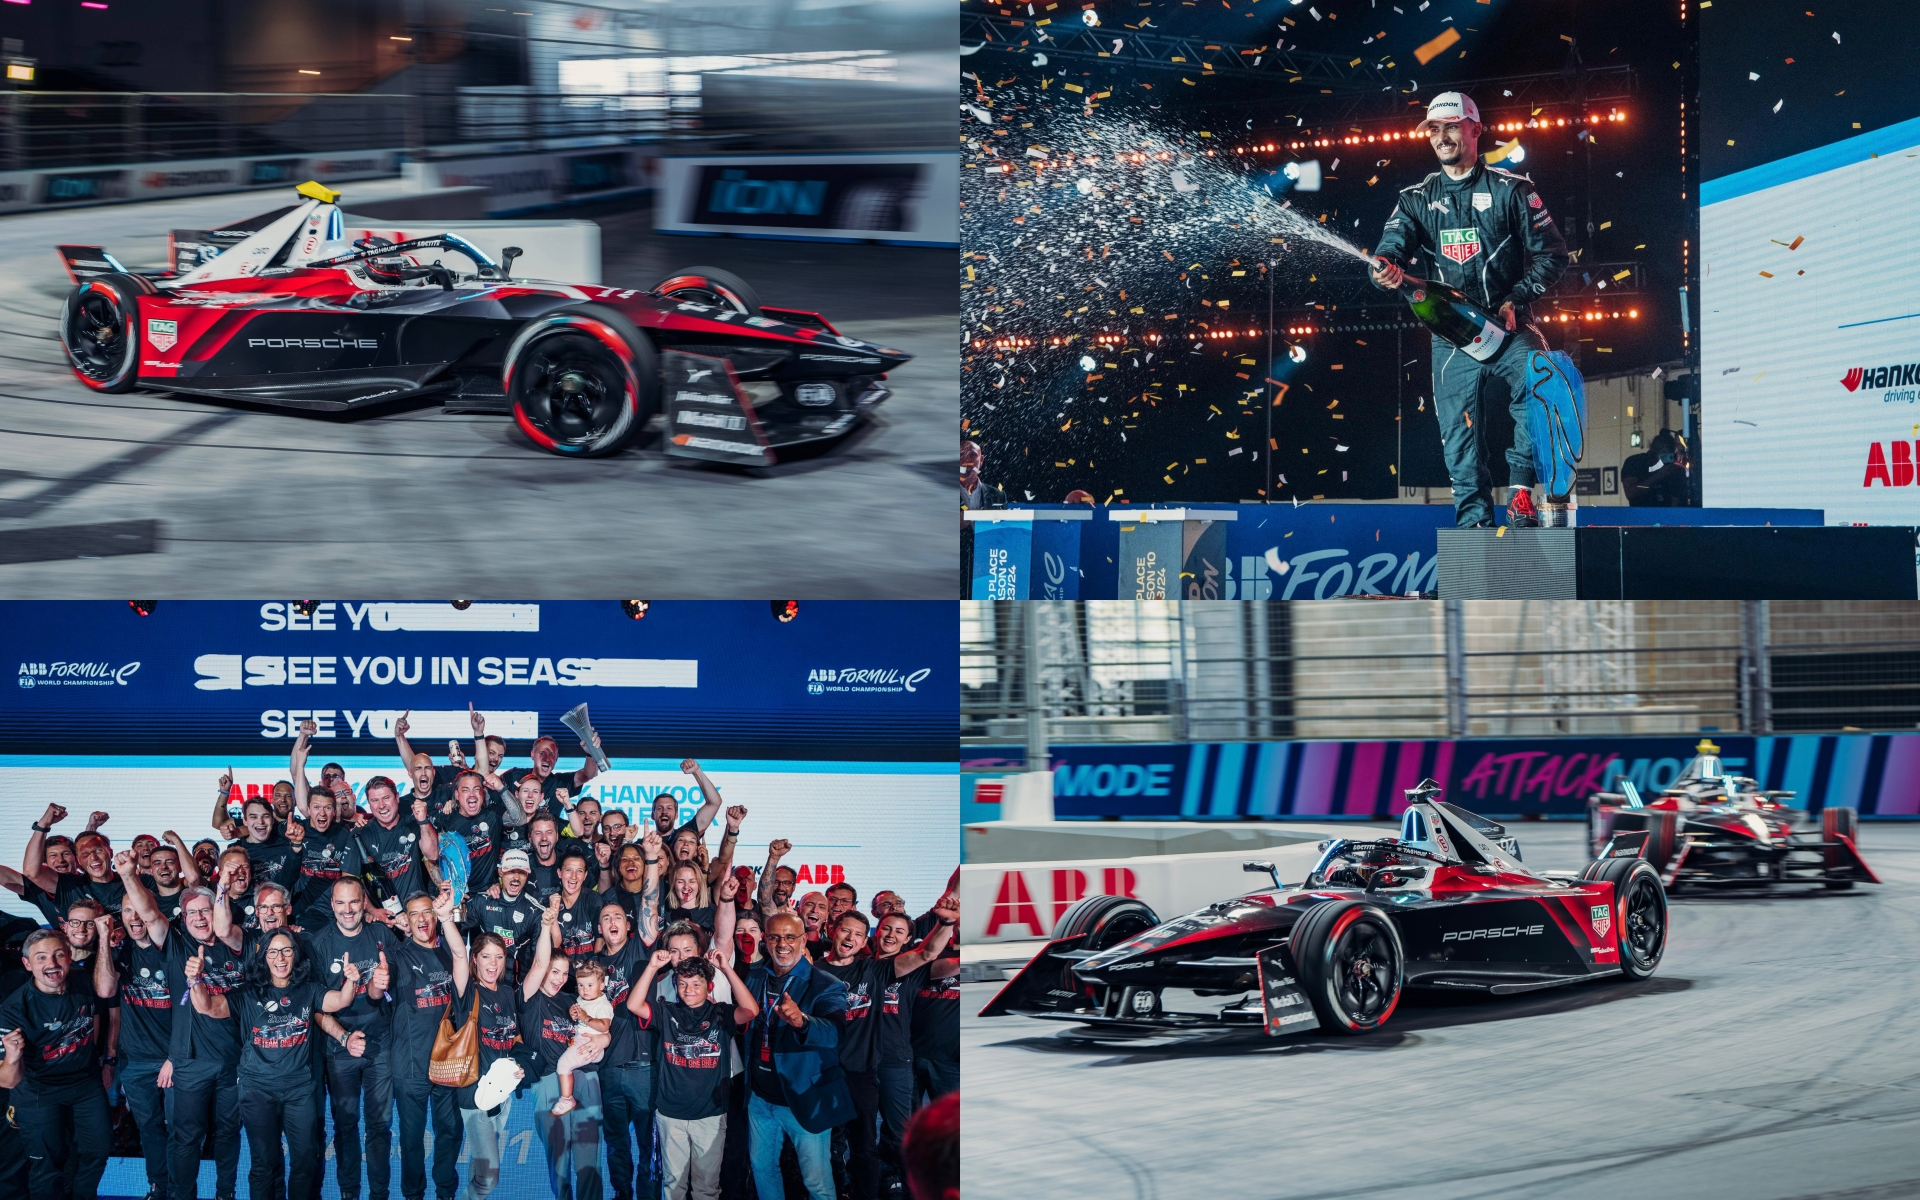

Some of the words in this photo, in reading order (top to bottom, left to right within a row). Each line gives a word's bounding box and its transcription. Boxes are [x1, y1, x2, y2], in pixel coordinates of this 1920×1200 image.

[1443, 231, 1476, 243] TAG
[1443, 244, 1479, 263] HEUER
[151, 321, 175, 333] TAG
[248, 338, 378, 349] PORSCHE
[1884, 390, 1915, 403] driving
[999, 549, 1008, 566] 10
[1147, 551, 1156, 568] 10
[988, 548, 998, 592] PLACE
[1136, 557, 1146, 600] PLACE
[260, 602, 336, 631] SEE
[18, 662, 48, 676] ABB
[343, 656, 422, 685] YOU
[431, 656, 469, 685] IN
[807, 669, 837, 682] ABB
[1054, 763, 1174, 797] MODE
[1461, 751, 1619, 802] ATTACK
[1501, 838, 1517, 855] 94
[795, 864, 845, 884] ABB
[1592, 907, 1608, 918] TAG
[1442, 924, 1544, 942] PORSCHE
[1592, 918, 1610, 937] HEUER
[1108, 960, 1154, 972] PORSCHE
